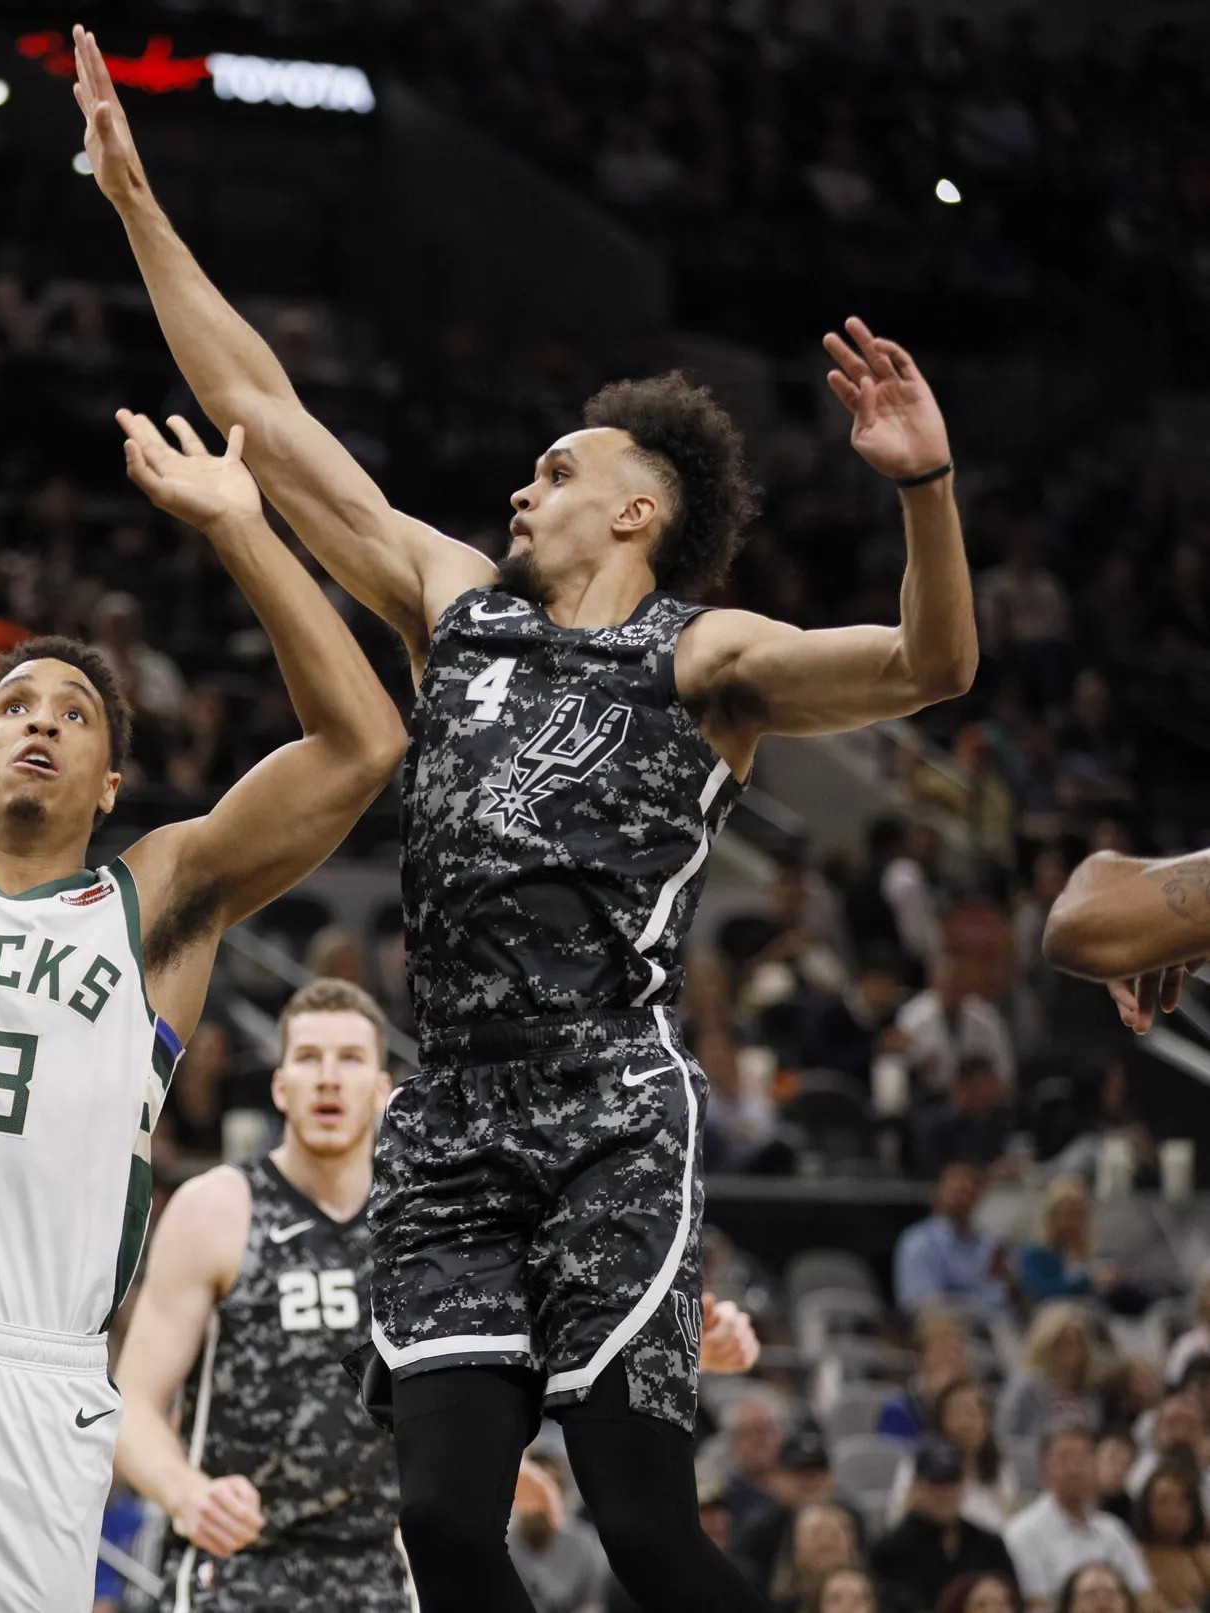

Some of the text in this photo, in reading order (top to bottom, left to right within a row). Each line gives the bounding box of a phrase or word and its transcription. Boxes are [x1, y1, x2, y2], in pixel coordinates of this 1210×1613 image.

[595, 630, 650, 646] Frost
[465, 657, 518, 722] 4
[277, 1268, 360, 1332] 25
